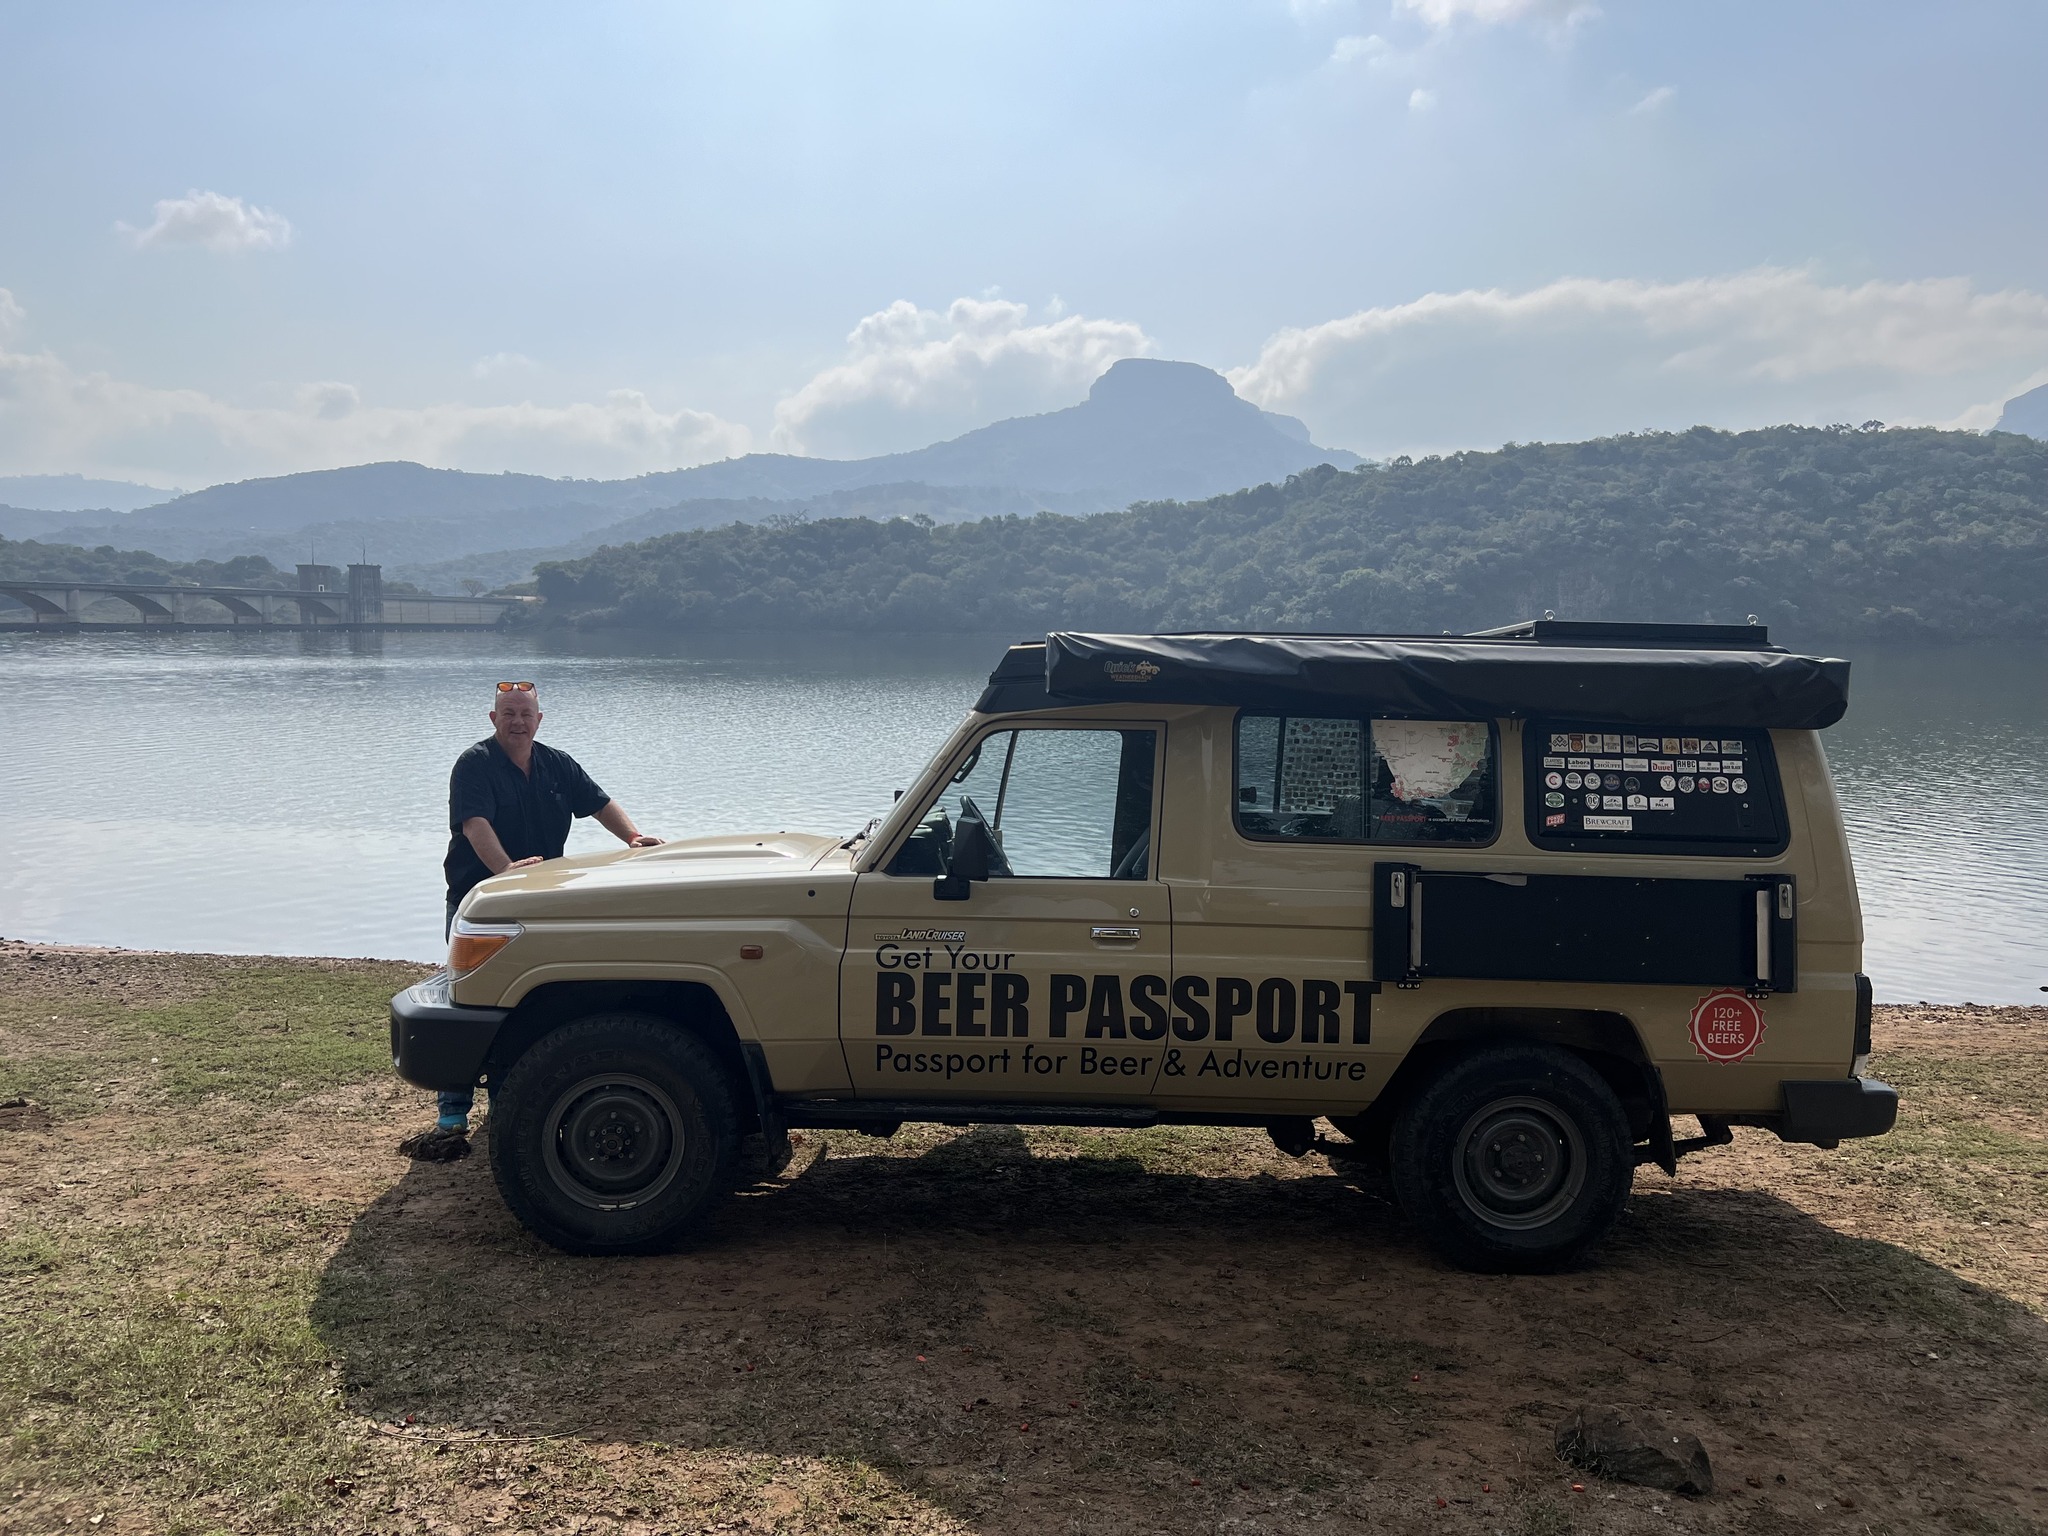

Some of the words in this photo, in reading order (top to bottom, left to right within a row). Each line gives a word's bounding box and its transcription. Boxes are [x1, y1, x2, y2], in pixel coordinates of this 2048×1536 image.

[1652, 763, 1673, 771] Duvel
[1585, 817, 1631, 826] BREWCRAFT
[876, 943, 933, 969] Get
[944, 944, 1015, 971] Your
[876, 972, 1030, 1038] BEER
[1049, 973, 1382, 1045] PASSPORT
[1714, 1008, 1742, 1019] 120+
[1712, 1020, 1741, 1031] FREE
[1707, 1033, 1745, 1044] BEERS
[876, 1044, 1011, 1079] Passport
[1023, 1045, 1067, 1075] for
[1081, 1048, 1153, 1076] Beer
[1164, 1049, 1187, 1077] &
[1197, 1050, 1366, 1082] Adventure
